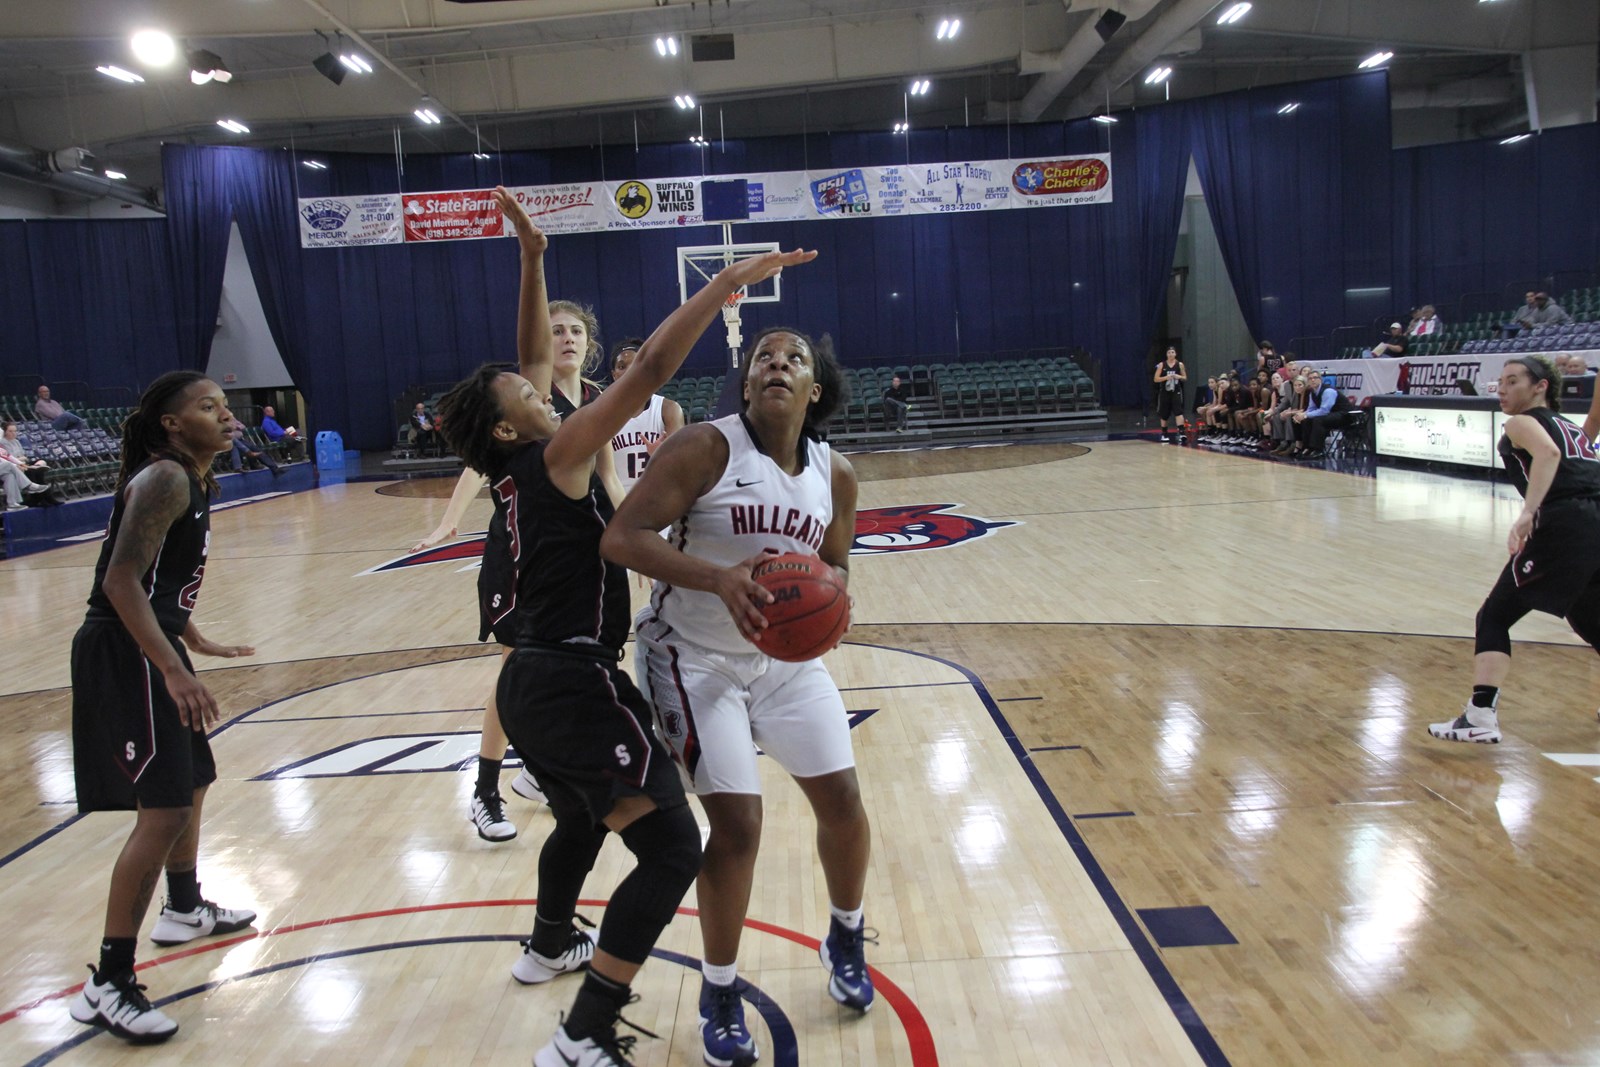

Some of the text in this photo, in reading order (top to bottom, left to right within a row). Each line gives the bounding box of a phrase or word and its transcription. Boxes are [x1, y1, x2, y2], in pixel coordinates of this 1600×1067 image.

[926, 163, 992, 184] ALL STAR TROPHY
[1043, 165, 1099, 178] Charlie's
[656, 182, 694, 191] BUFFALO
[1044, 177, 1096, 189] Chicken
[515, 187, 592, 211] Progress!
[657, 190, 695, 203] WILD
[1040, 198, 1055, 206] just
[300, 199, 352, 218] KISSEE
[658, 202, 695, 213] WINGS
[841, 203, 871, 213] TTCU
[940, 203, 981, 211] 283-2200
[360, 213, 395, 222] 341-0101
[410, 219, 431, 228] David
[475, 216, 497, 226] Agent
[638, 219, 666, 227] Sponsor
[308, 231, 348, 240] MERCURY
[1405, 363, 1481, 386] HILLCAT
[627, 451, 650, 479] 13
[731, 504, 825, 548] HILLCATS
[1522, 560, 1533, 573] S
[491, 593, 501, 608] S
[126, 741, 136, 761] S
[615, 744, 631, 766] S
